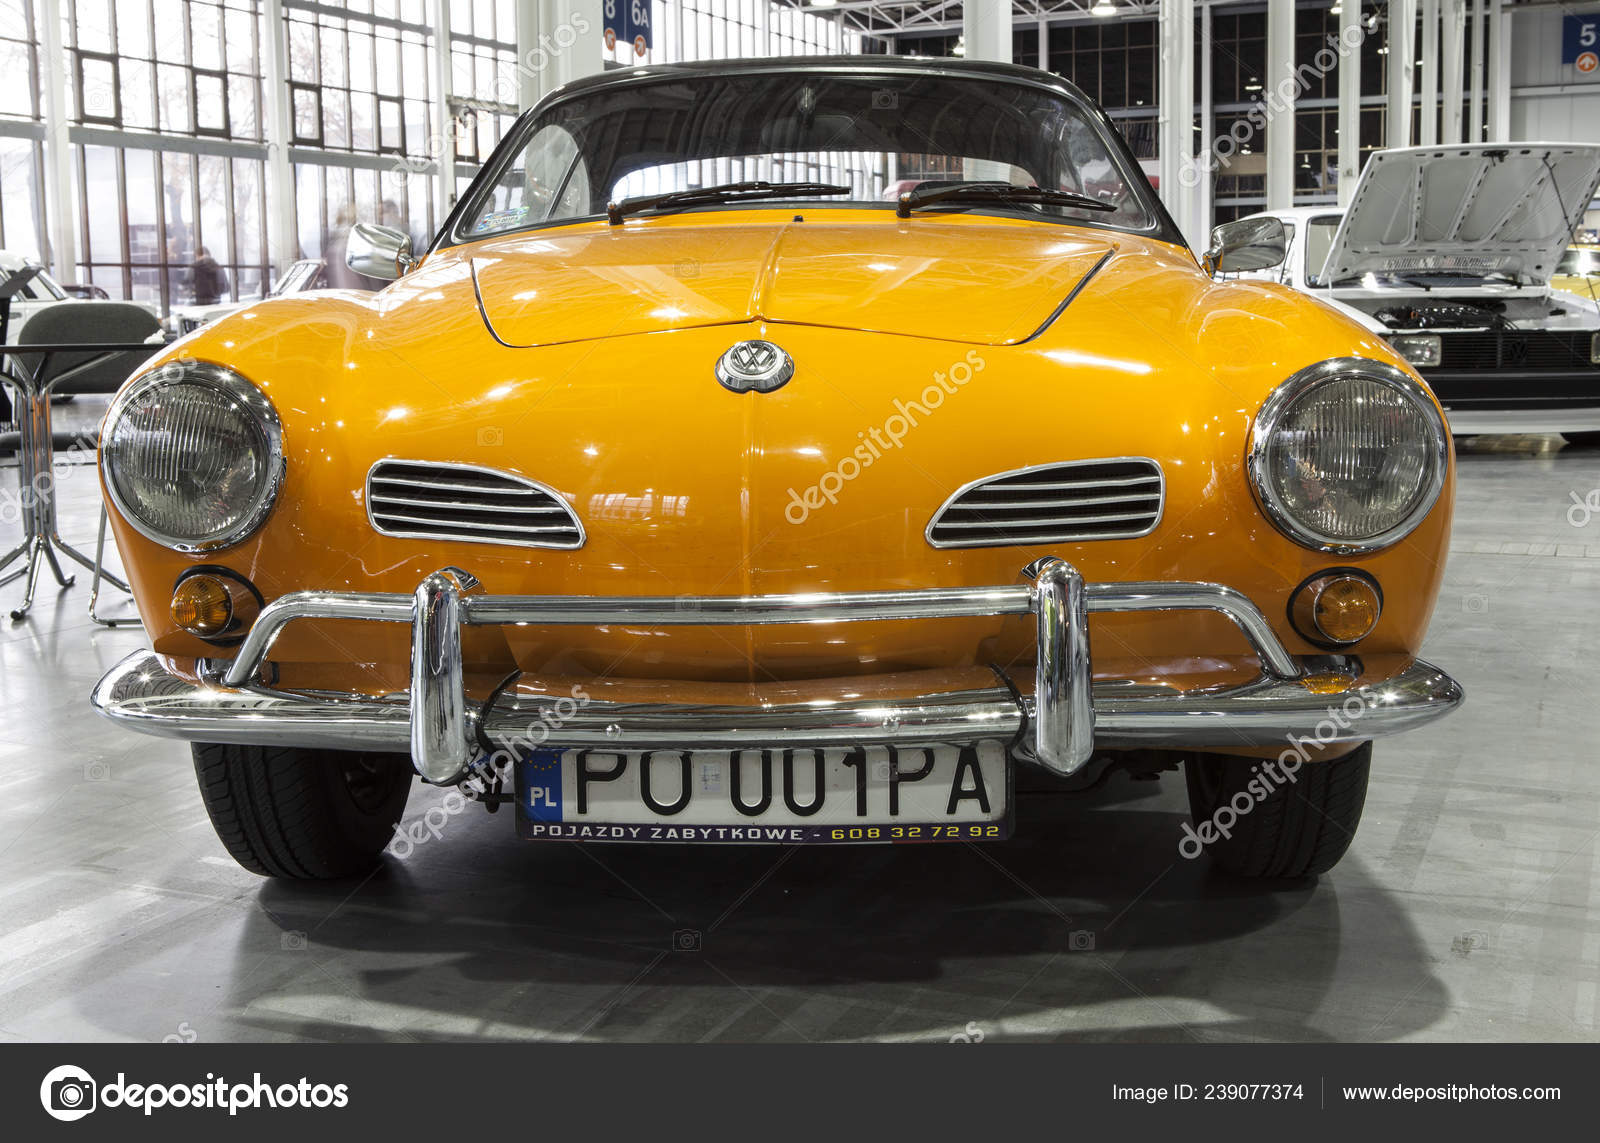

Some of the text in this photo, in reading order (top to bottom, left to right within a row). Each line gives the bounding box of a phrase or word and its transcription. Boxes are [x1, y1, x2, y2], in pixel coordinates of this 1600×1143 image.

[604, 0, 616, 19] 8
[632, 0, 649, 28] 6A
[1580, 24, 1597, 46] 5
[576, 749, 694, 816] PO
[730, 741, 991, 817] 001PA
[529, 786, 558, 808] PL
[533, 824, 641, 838] POJAZDY
[650, 827, 804, 841] ZABYTKOWE
[831, 827, 881, 840] 608
[891, 827, 922, 838] 32
[931, 826, 961, 838] 72
[969, 826, 999, 838] 92
